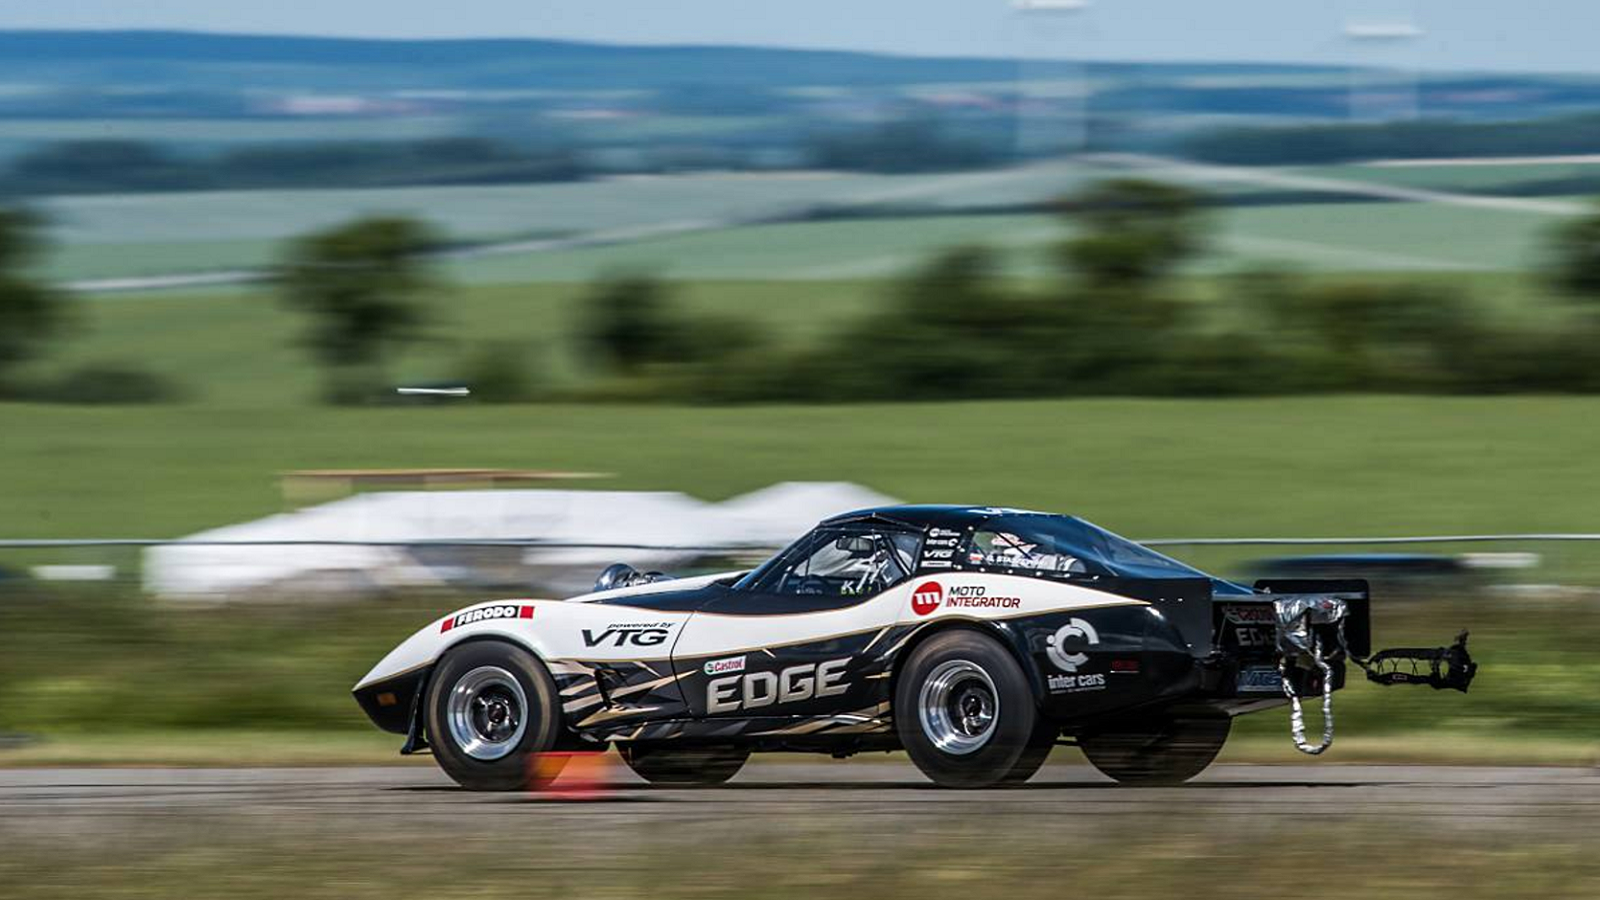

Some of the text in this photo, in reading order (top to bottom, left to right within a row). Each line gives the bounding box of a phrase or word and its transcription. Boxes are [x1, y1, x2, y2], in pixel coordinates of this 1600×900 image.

[949, 586, 986, 596] MOTO
[946, 597, 1021, 608] INTEGRATOR
[457, 606, 516, 626] FERODO
[607, 621, 675, 630] powered by
[581, 629, 670, 648] VTG
[714, 657, 744, 672] Castrol
[706, 656, 853, 714] EDGE
[1047, 673, 1105, 689] inter cars
